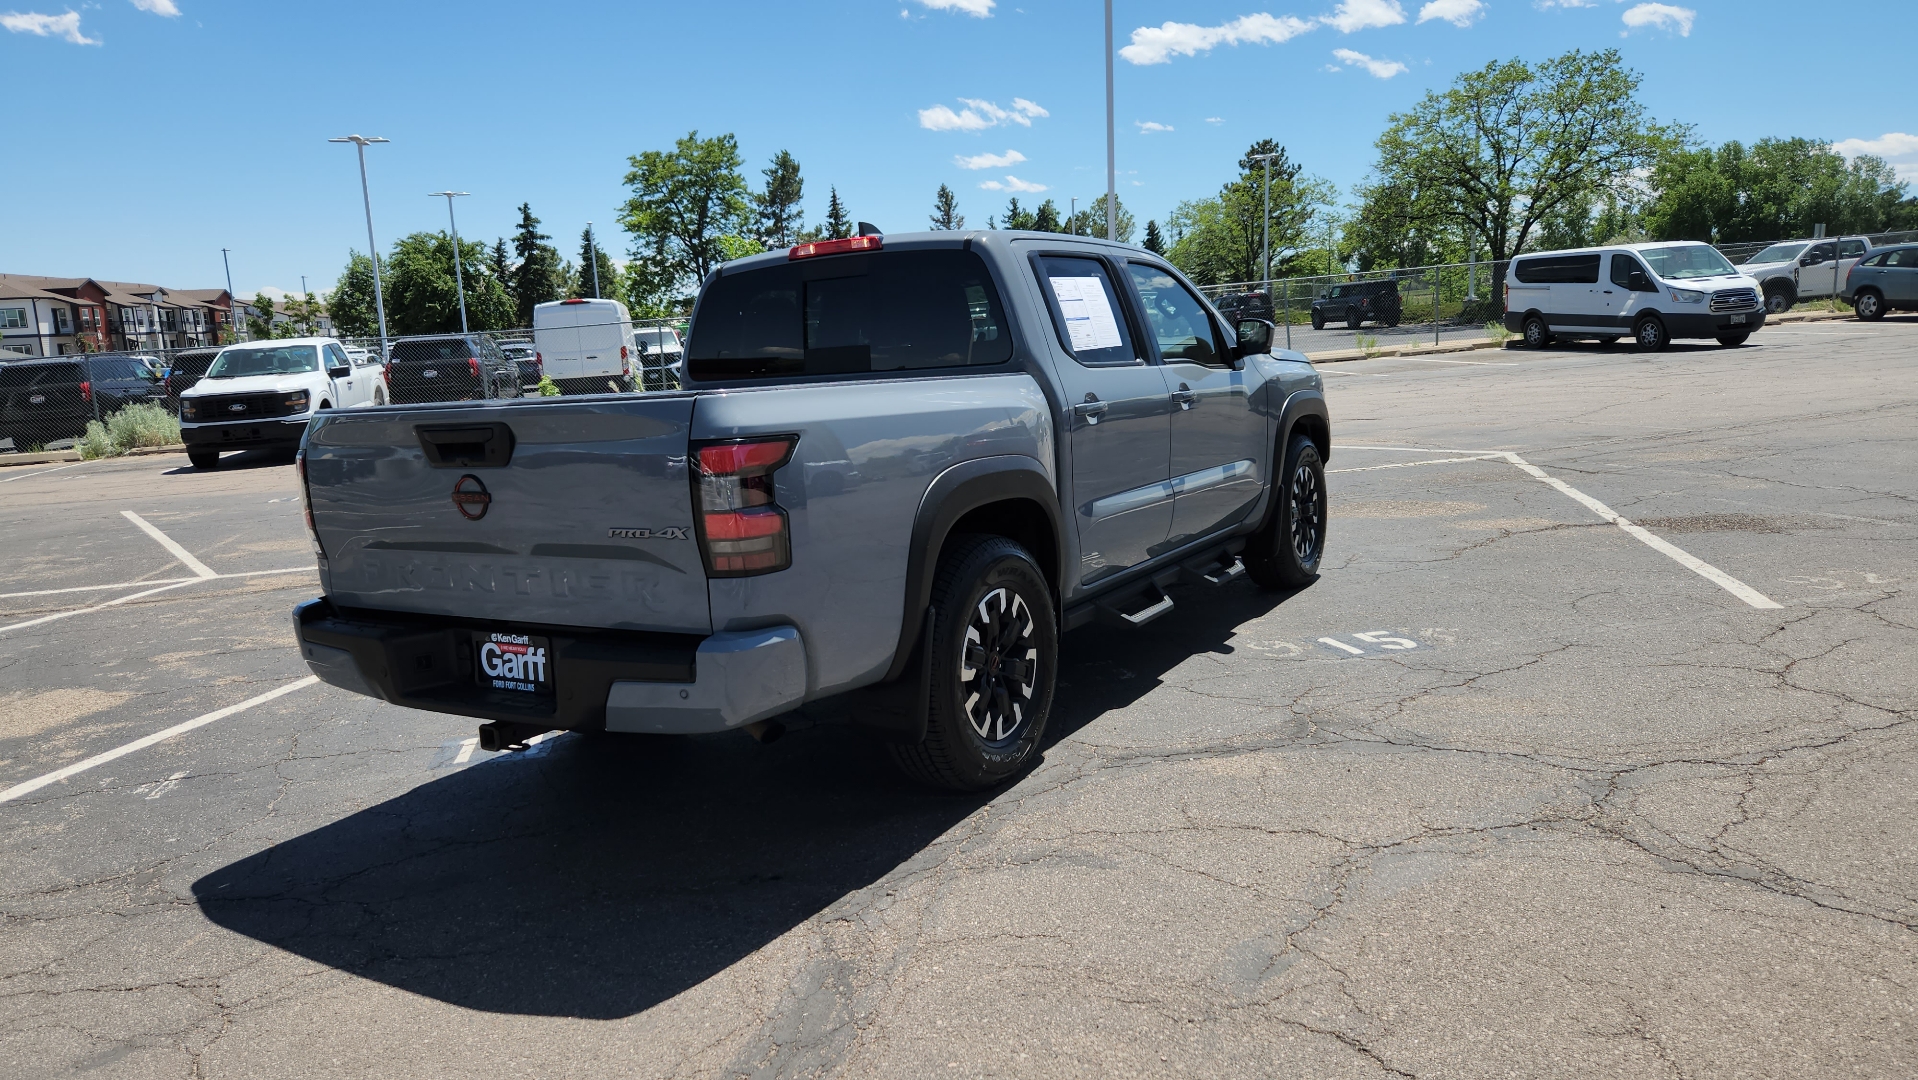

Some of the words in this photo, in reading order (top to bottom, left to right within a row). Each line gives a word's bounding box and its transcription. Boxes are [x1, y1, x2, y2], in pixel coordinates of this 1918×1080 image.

[608, 526, 691, 540] PRO-4X
[497, 633, 511, 643] Ken
[511, 634, 529, 645] Garff
[1317, 630, 1418, 655] 15
[481, 642, 546, 682] Garff
[493, 680, 504, 688] FORD
[505, 681, 516, 690] FORT
[517, 682, 535, 692] COLLINS
